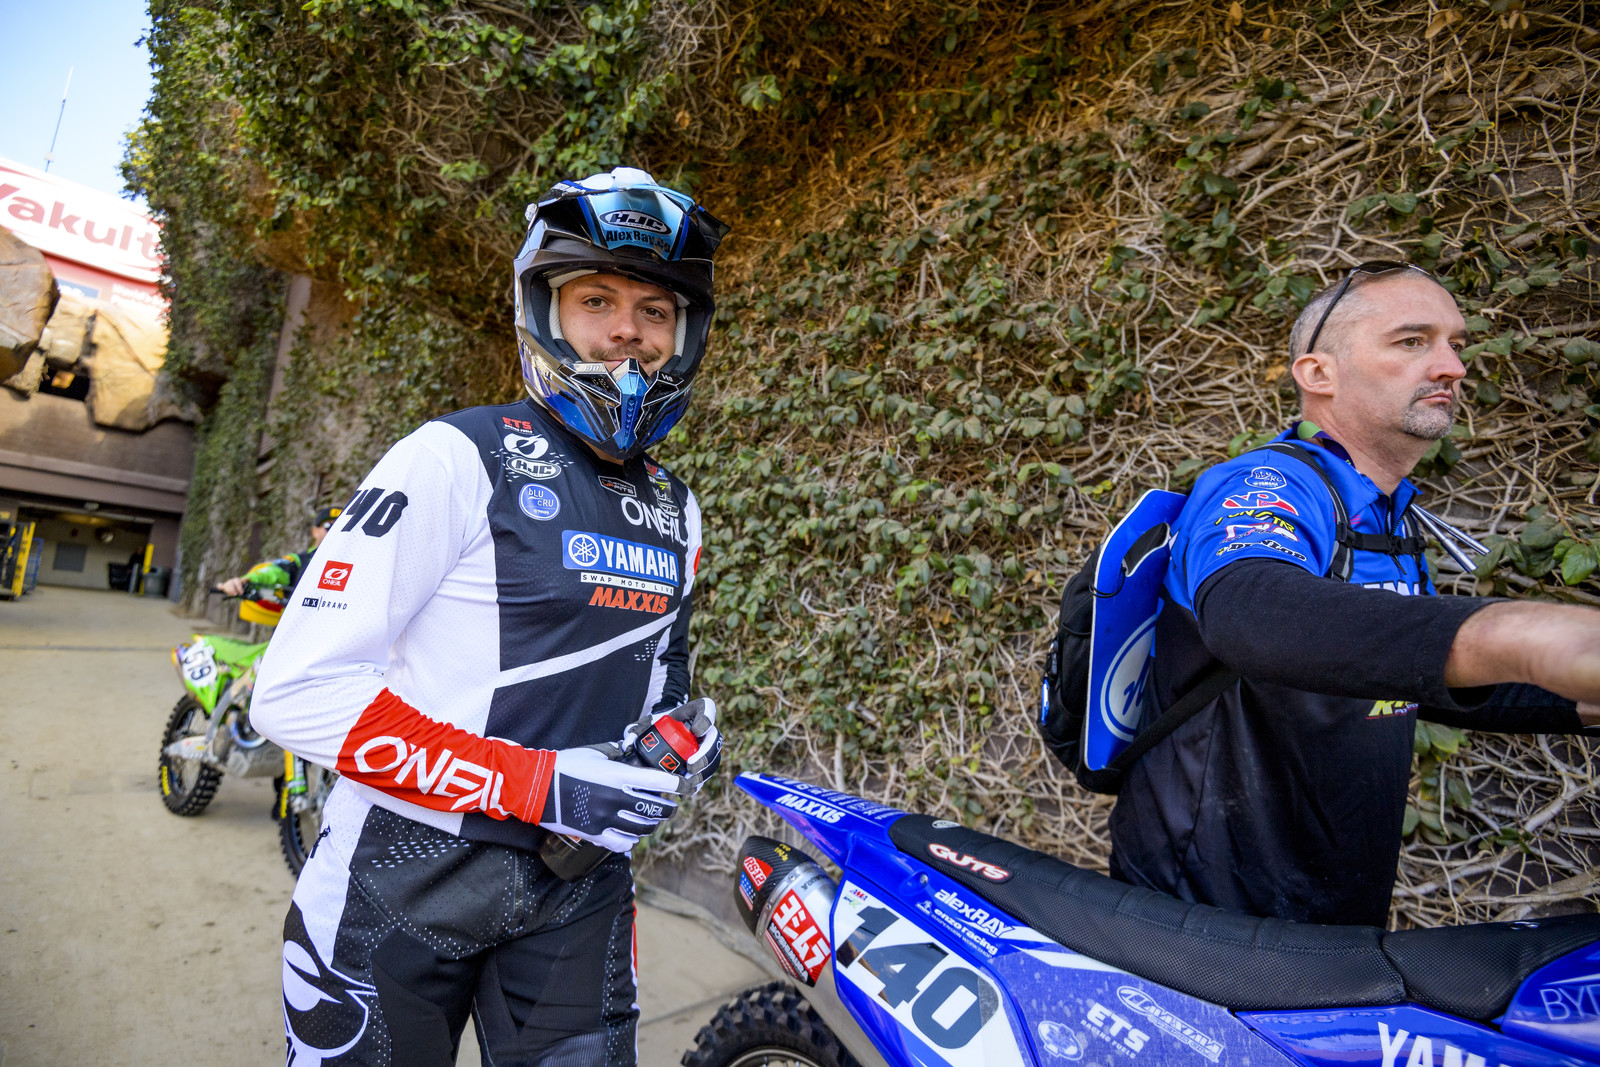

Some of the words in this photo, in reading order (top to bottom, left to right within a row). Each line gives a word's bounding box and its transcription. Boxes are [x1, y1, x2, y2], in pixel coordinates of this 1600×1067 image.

[609, 213, 664, 231] HJC
[502, 416, 533, 431] ETS
[515, 460, 552, 474] HJC
[601, 538, 678, 583] YAMAHA
[582, 574, 613, 583] SWAP
[620, 579, 646, 589] MOTO
[654, 584, 674, 595] LIVE
[588, 586, 669, 614] MAXXIS
[303, 598, 317, 607] MX
[321, 600, 348, 610] BRAND
[775, 793, 846, 824] MAXXIS
[928, 843, 1010, 880] GUTS
[934, 889, 1015, 937] alexRAY
[934, 908, 963, 930] enzo
[961, 926, 999, 956] racing
[836, 906, 1000, 1050] 140
[1086, 1002, 1150, 1054] ETS
